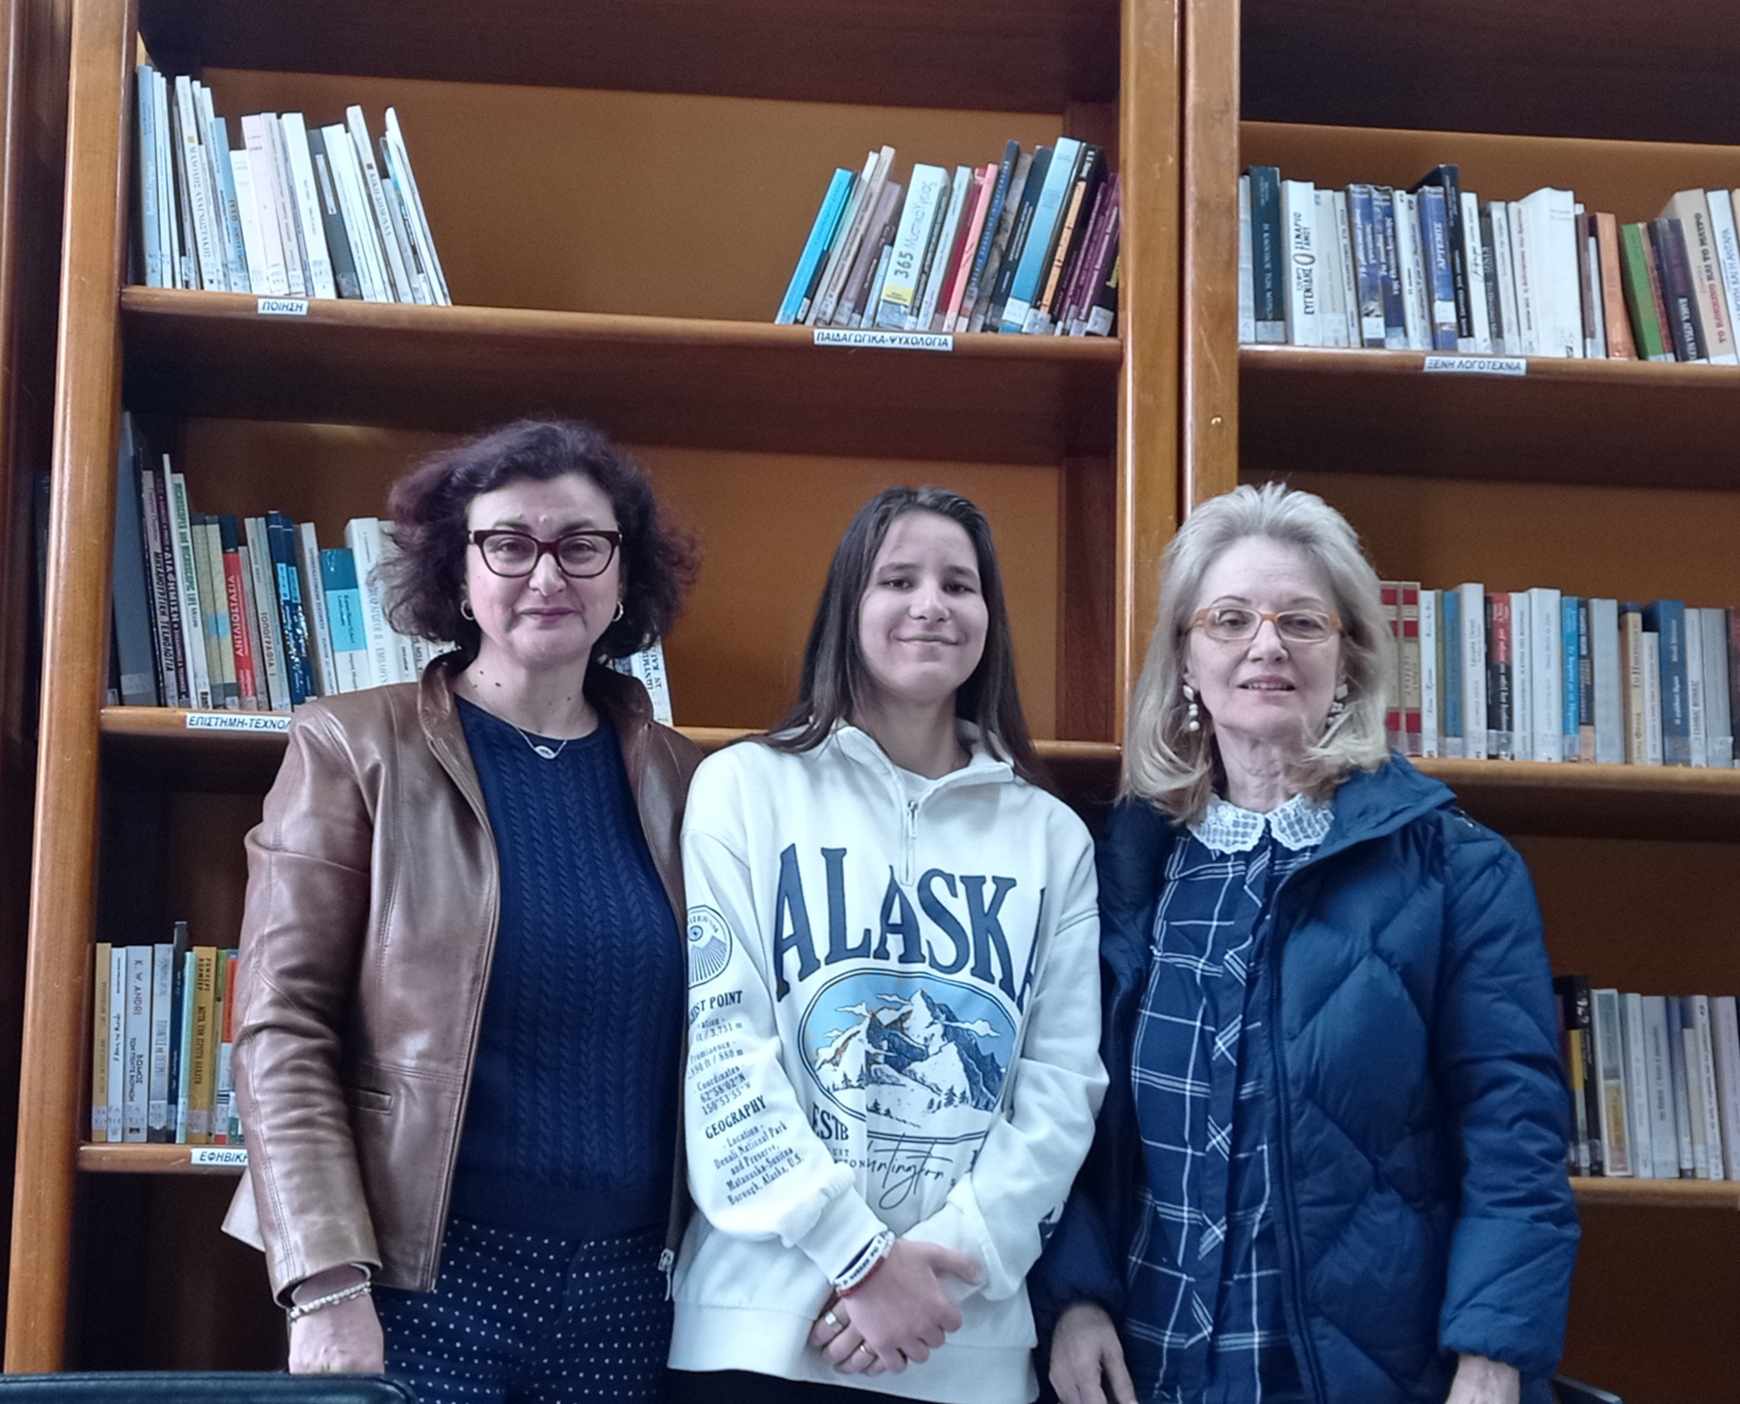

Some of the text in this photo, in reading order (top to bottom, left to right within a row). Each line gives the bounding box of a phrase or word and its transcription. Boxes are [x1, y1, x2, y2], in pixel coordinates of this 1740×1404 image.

[1693, 211, 1707, 246] ΜΑΥΡΟ
[1699, 247, 1710, 262] ΤΟ
[894, 251, 914, 279] 365
[1703, 263, 1714, 281] ΚΑΙ
[262, 300, 304, 312] ΠΟΙΗΣΗ
[816, 332, 949, 348] ΠΑΙΔΑΓΩΓΙΚΑ-ΨΥΧΟΛΟΓΙΑ
[1427, 358, 1522, 371] ΞΕΝΗ ΛΟΓΟΤΕΧΝΙΑ
[163, 550, 180, 622] ΔΙΑΦΗΜΙΣΗ
[226, 574, 245, 657] ΑΝΤΛΙΟΣΤΑΣΙΑ
[260, 611, 276, 669] ΤΟΠΟΓΡΑΦΙΑ
[709, 991, 742, 1010] POINT
[705, 1095, 766, 1139] GEOGRAPHY
[727, 1126, 759, 1149] Location
[768, 1120, 788, 1139] Park
[730, 1160, 745, 1175] and
